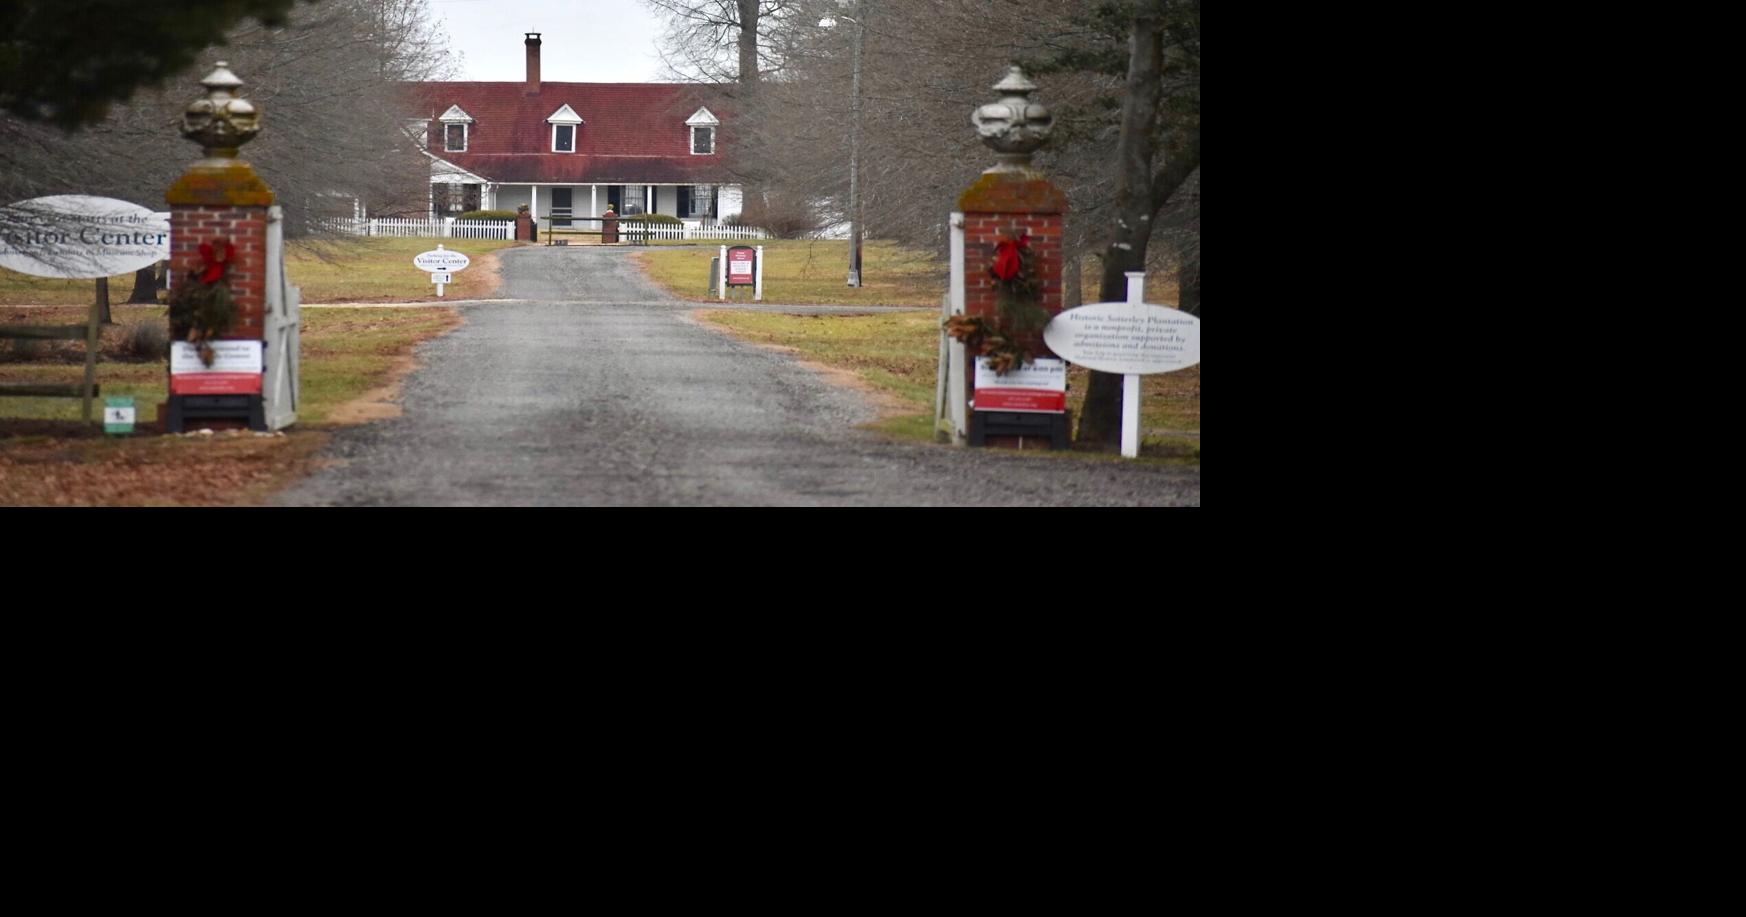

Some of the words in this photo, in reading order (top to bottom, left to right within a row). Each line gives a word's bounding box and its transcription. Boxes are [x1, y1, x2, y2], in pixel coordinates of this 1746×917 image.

[127, 213, 148, 224] the
[79, 226, 167, 246] Center
[1070, 313, 1103, 322] Historic
[1147, 316, 1194, 326] Plantation
[1084, 323, 1092, 331] is
[1145, 325, 1177, 336] private
[1074, 333, 1129, 345] organization
[1131, 335, 1174, 344] supported
[1176, 335, 1187, 345] by
